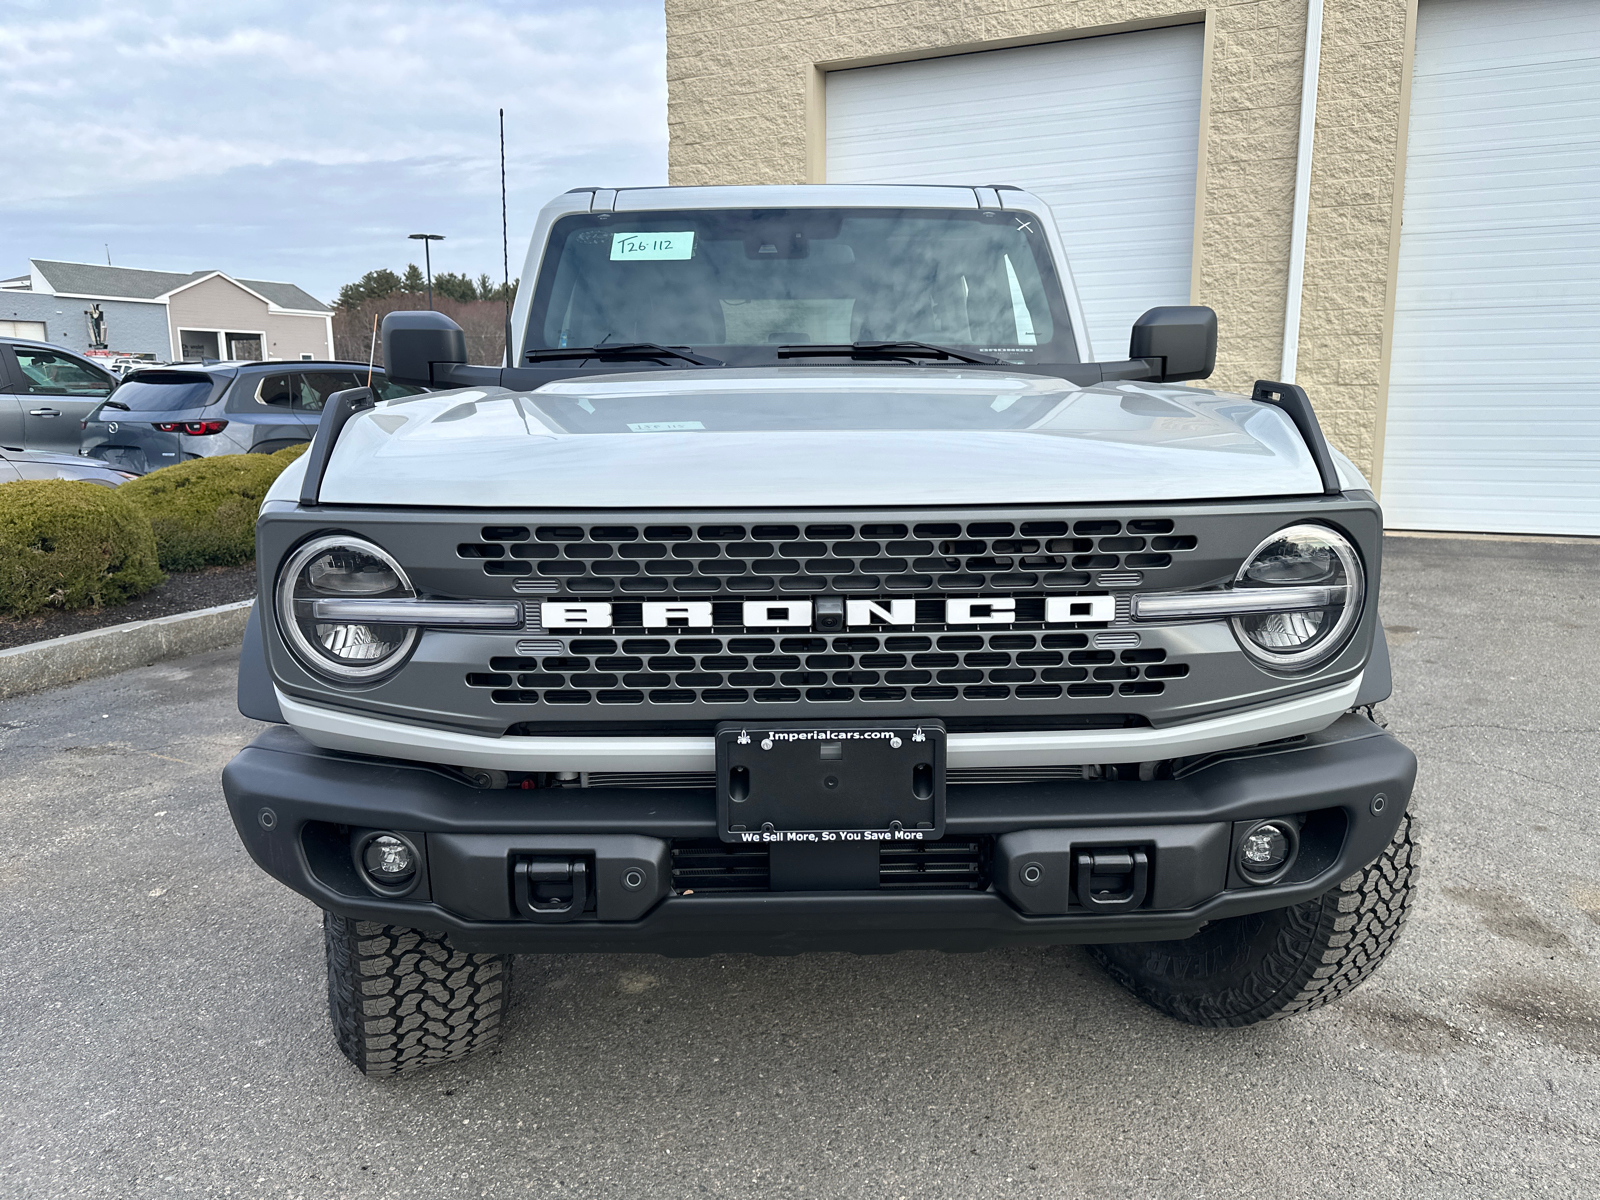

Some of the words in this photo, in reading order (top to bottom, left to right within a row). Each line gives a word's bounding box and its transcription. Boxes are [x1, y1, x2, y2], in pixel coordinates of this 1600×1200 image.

[540, 595, 1117, 629] BRONCO
[768, 730, 895, 742] Imperialcars.com
[741, 833, 760, 841] We
[763, 832, 784, 841] Sell
[787, 832, 819, 842] More,
[821, 832, 837, 841] So
[839, 831, 861, 840] You
[864, 831, 892, 840] Save
[895, 830, 923, 840] More
